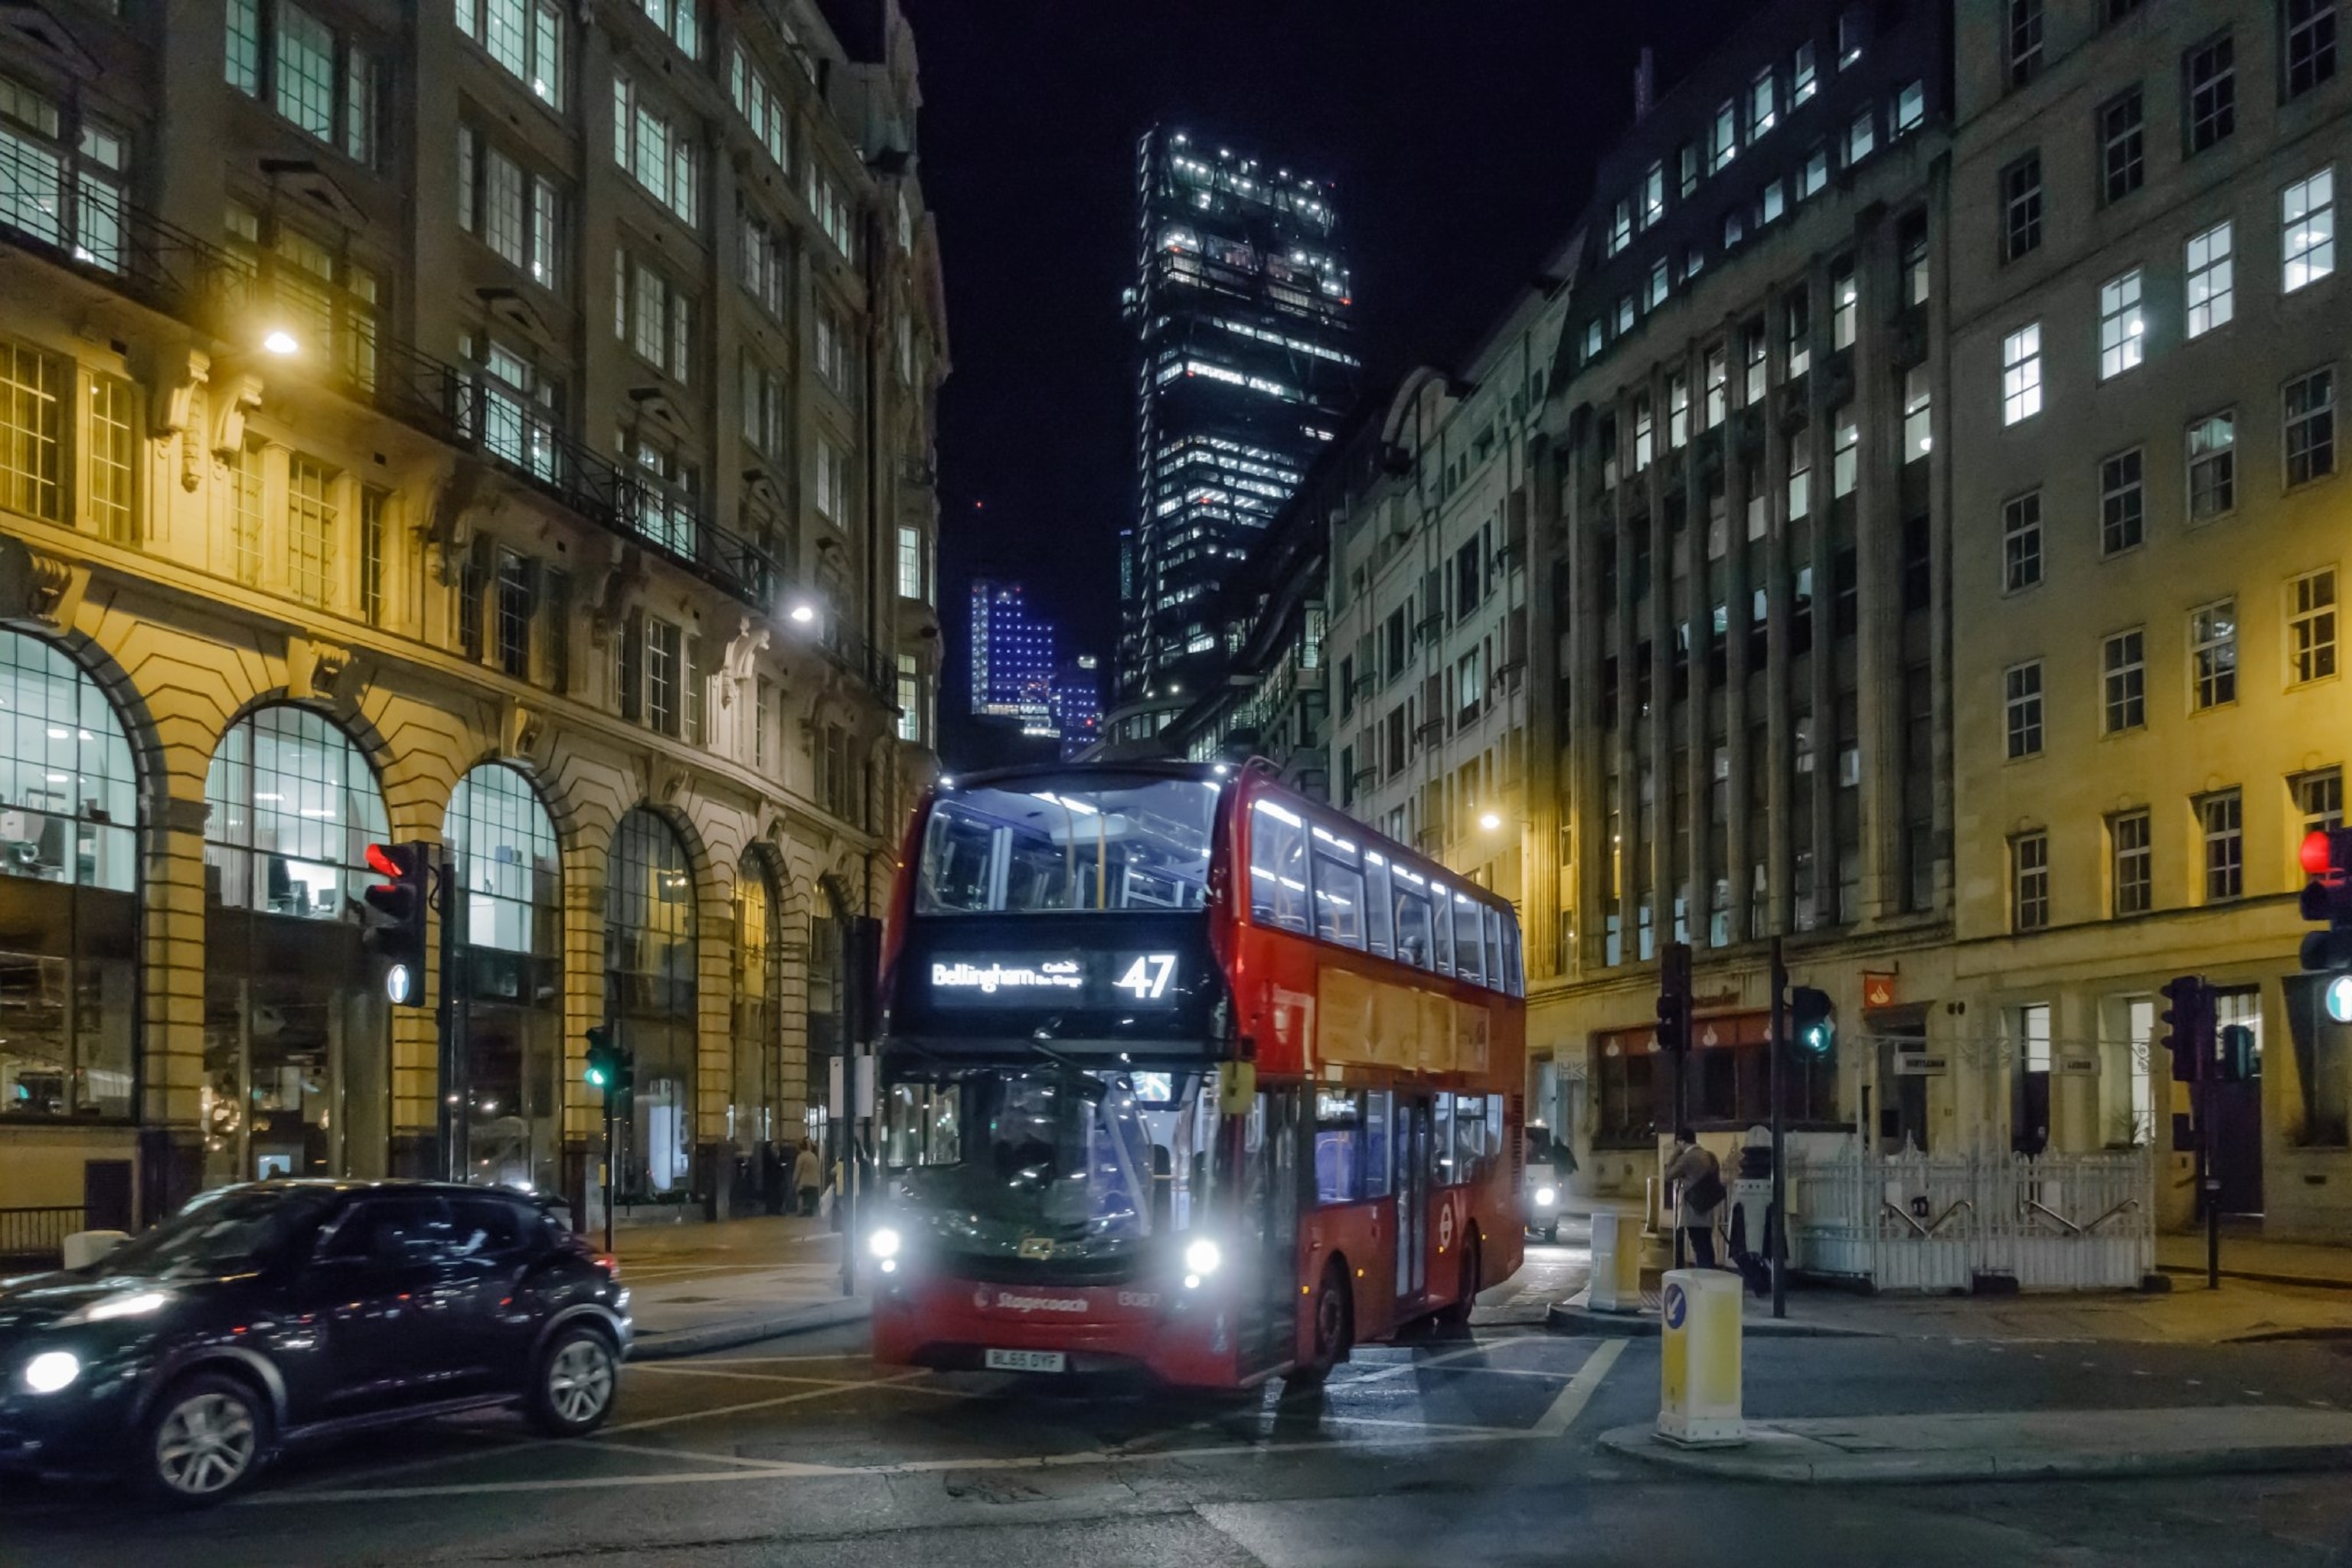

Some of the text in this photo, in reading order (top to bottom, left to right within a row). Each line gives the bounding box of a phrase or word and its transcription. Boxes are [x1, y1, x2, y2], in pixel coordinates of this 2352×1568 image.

[933, 963, 1035, 992] Bellingham
[1118, 955, 1176, 998] 47
[996, 1292, 1088, 1312] Stagecoach
